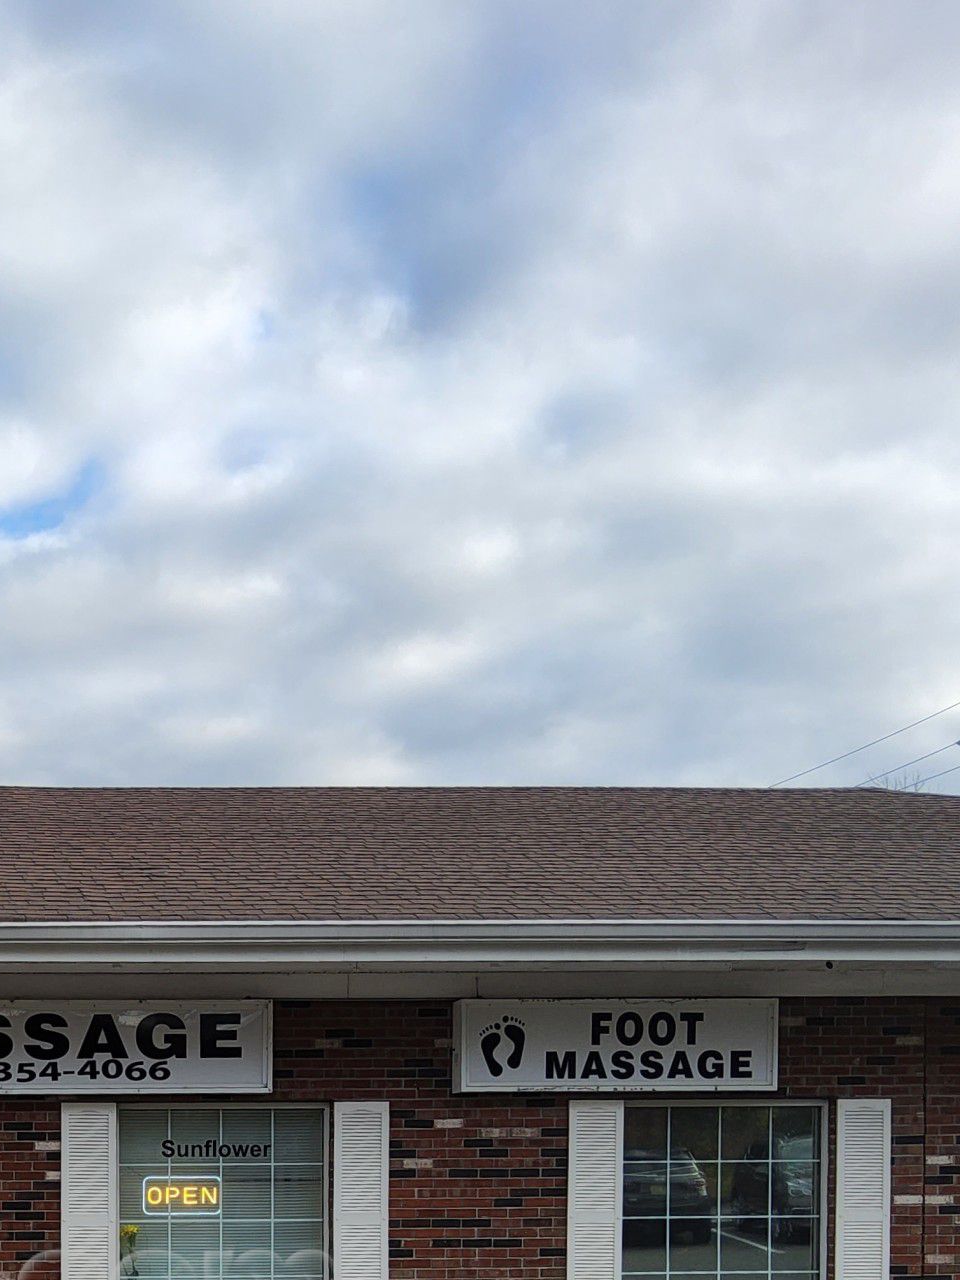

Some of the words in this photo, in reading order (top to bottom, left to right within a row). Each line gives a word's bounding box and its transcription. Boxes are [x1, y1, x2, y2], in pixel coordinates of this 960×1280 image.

[591, 1011, 704, 1046] FOOT
[546, 1050, 752, 1079] MASSAGE
[161, 1140, 271, 1158] Sunflower
[147, 1186, 218, 1206] OPEN
